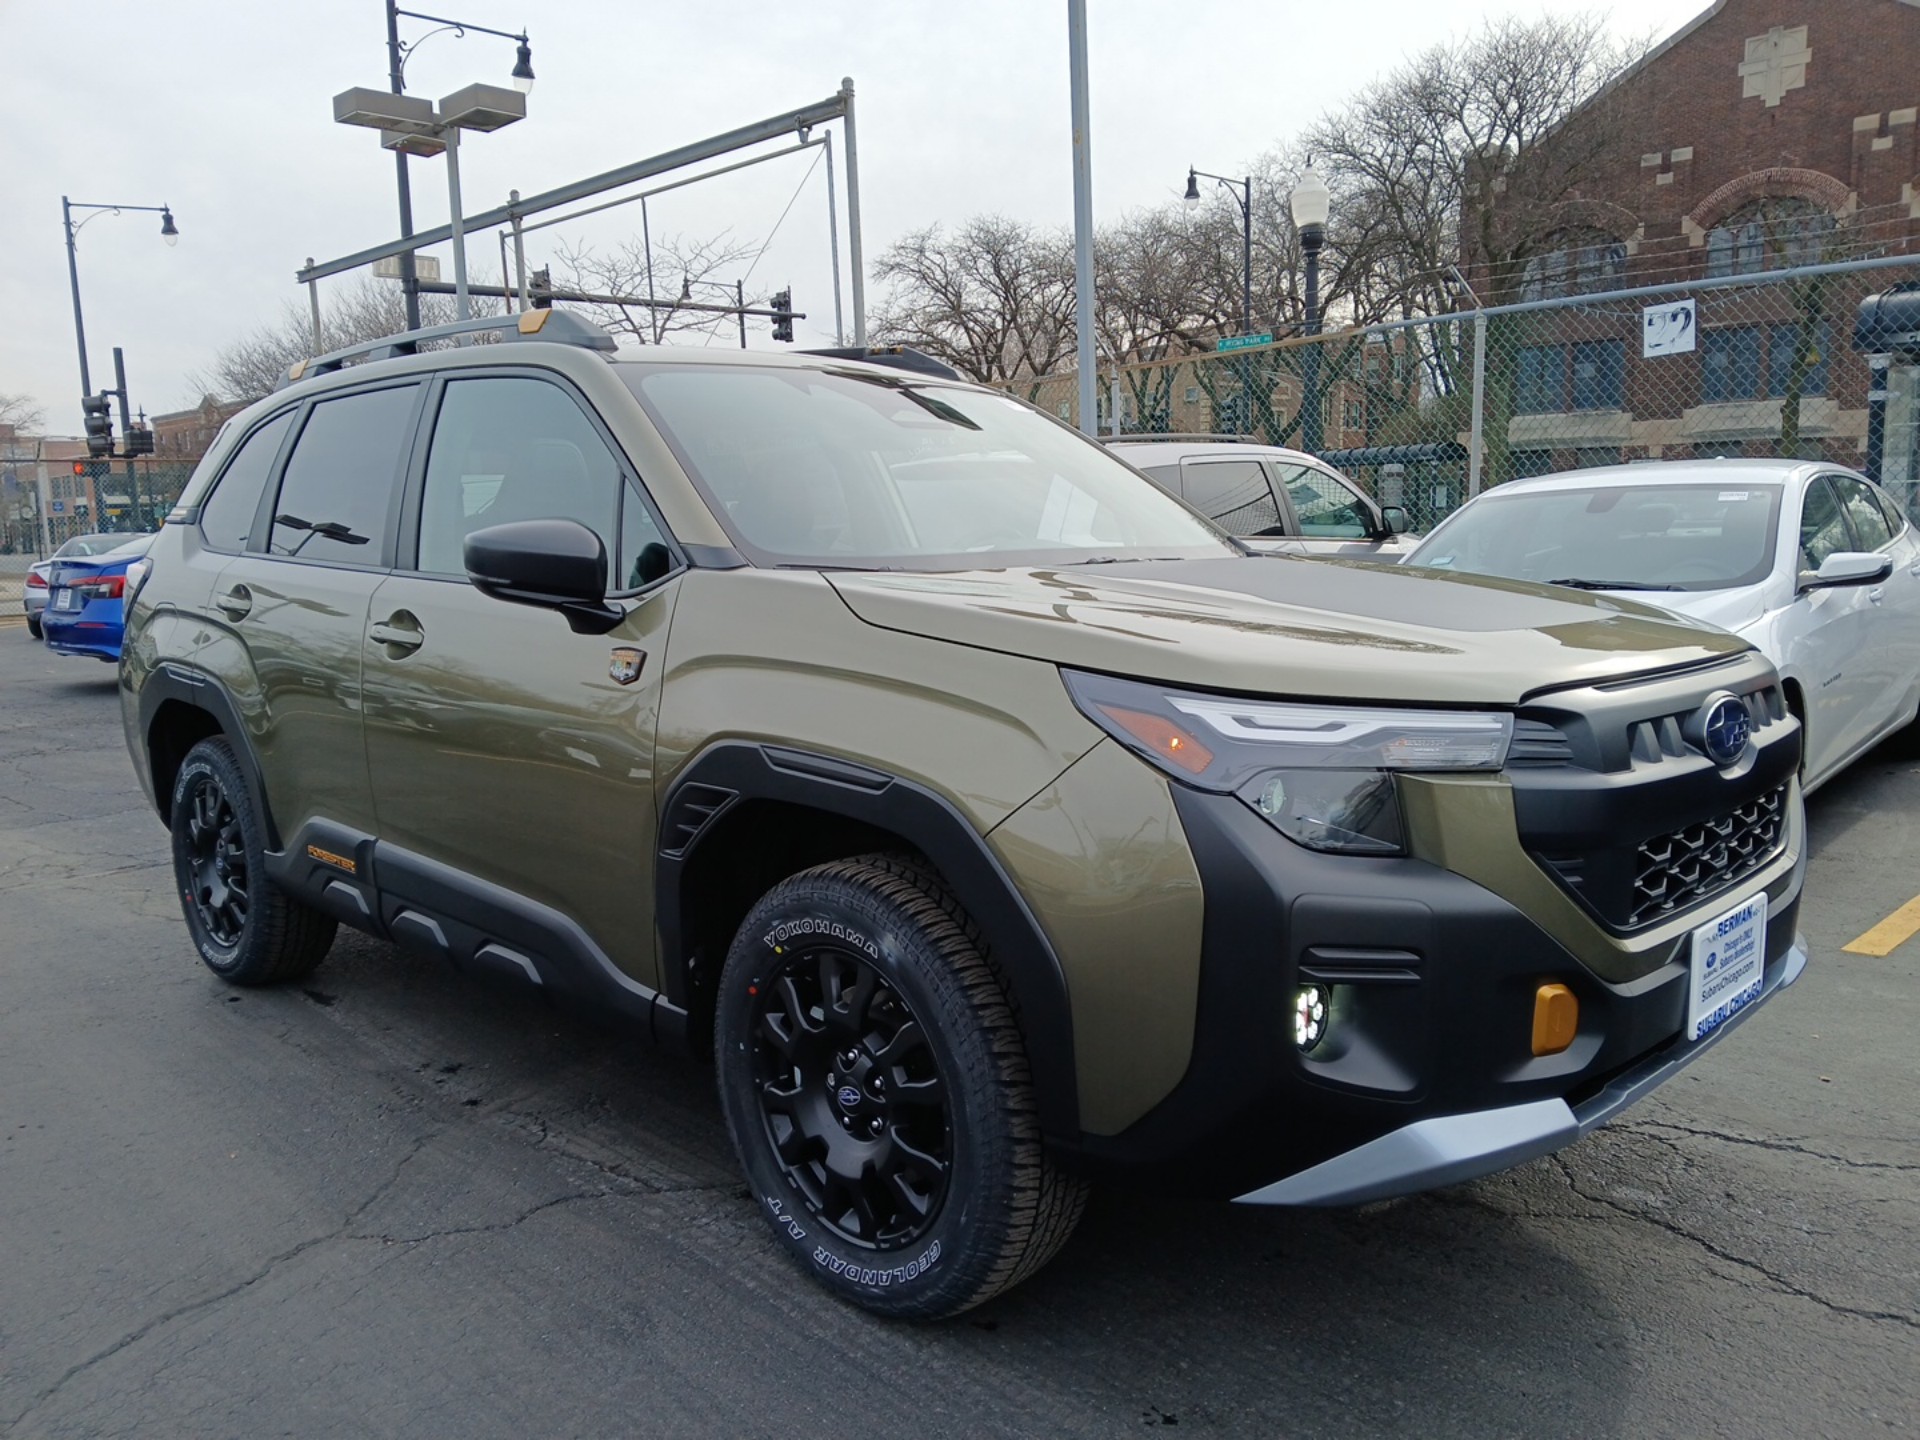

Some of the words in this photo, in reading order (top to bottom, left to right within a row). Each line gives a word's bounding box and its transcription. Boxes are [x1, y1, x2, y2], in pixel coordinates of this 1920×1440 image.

[307, 844, 356, 873] FORESTER
[763, 918, 878, 960] YOKOHAMA
[1718, 904, 1753, 938] BERMAN
[1701, 960, 1754, 1003] SubaruChicago.com
[1697, 1001, 1729, 1039] SUBARU
[1730, 979, 1761, 1016] CHICAGO
[767, 1197, 806, 1240] A/T
[812, 1240, 941, 1286] GEOLANDAR
